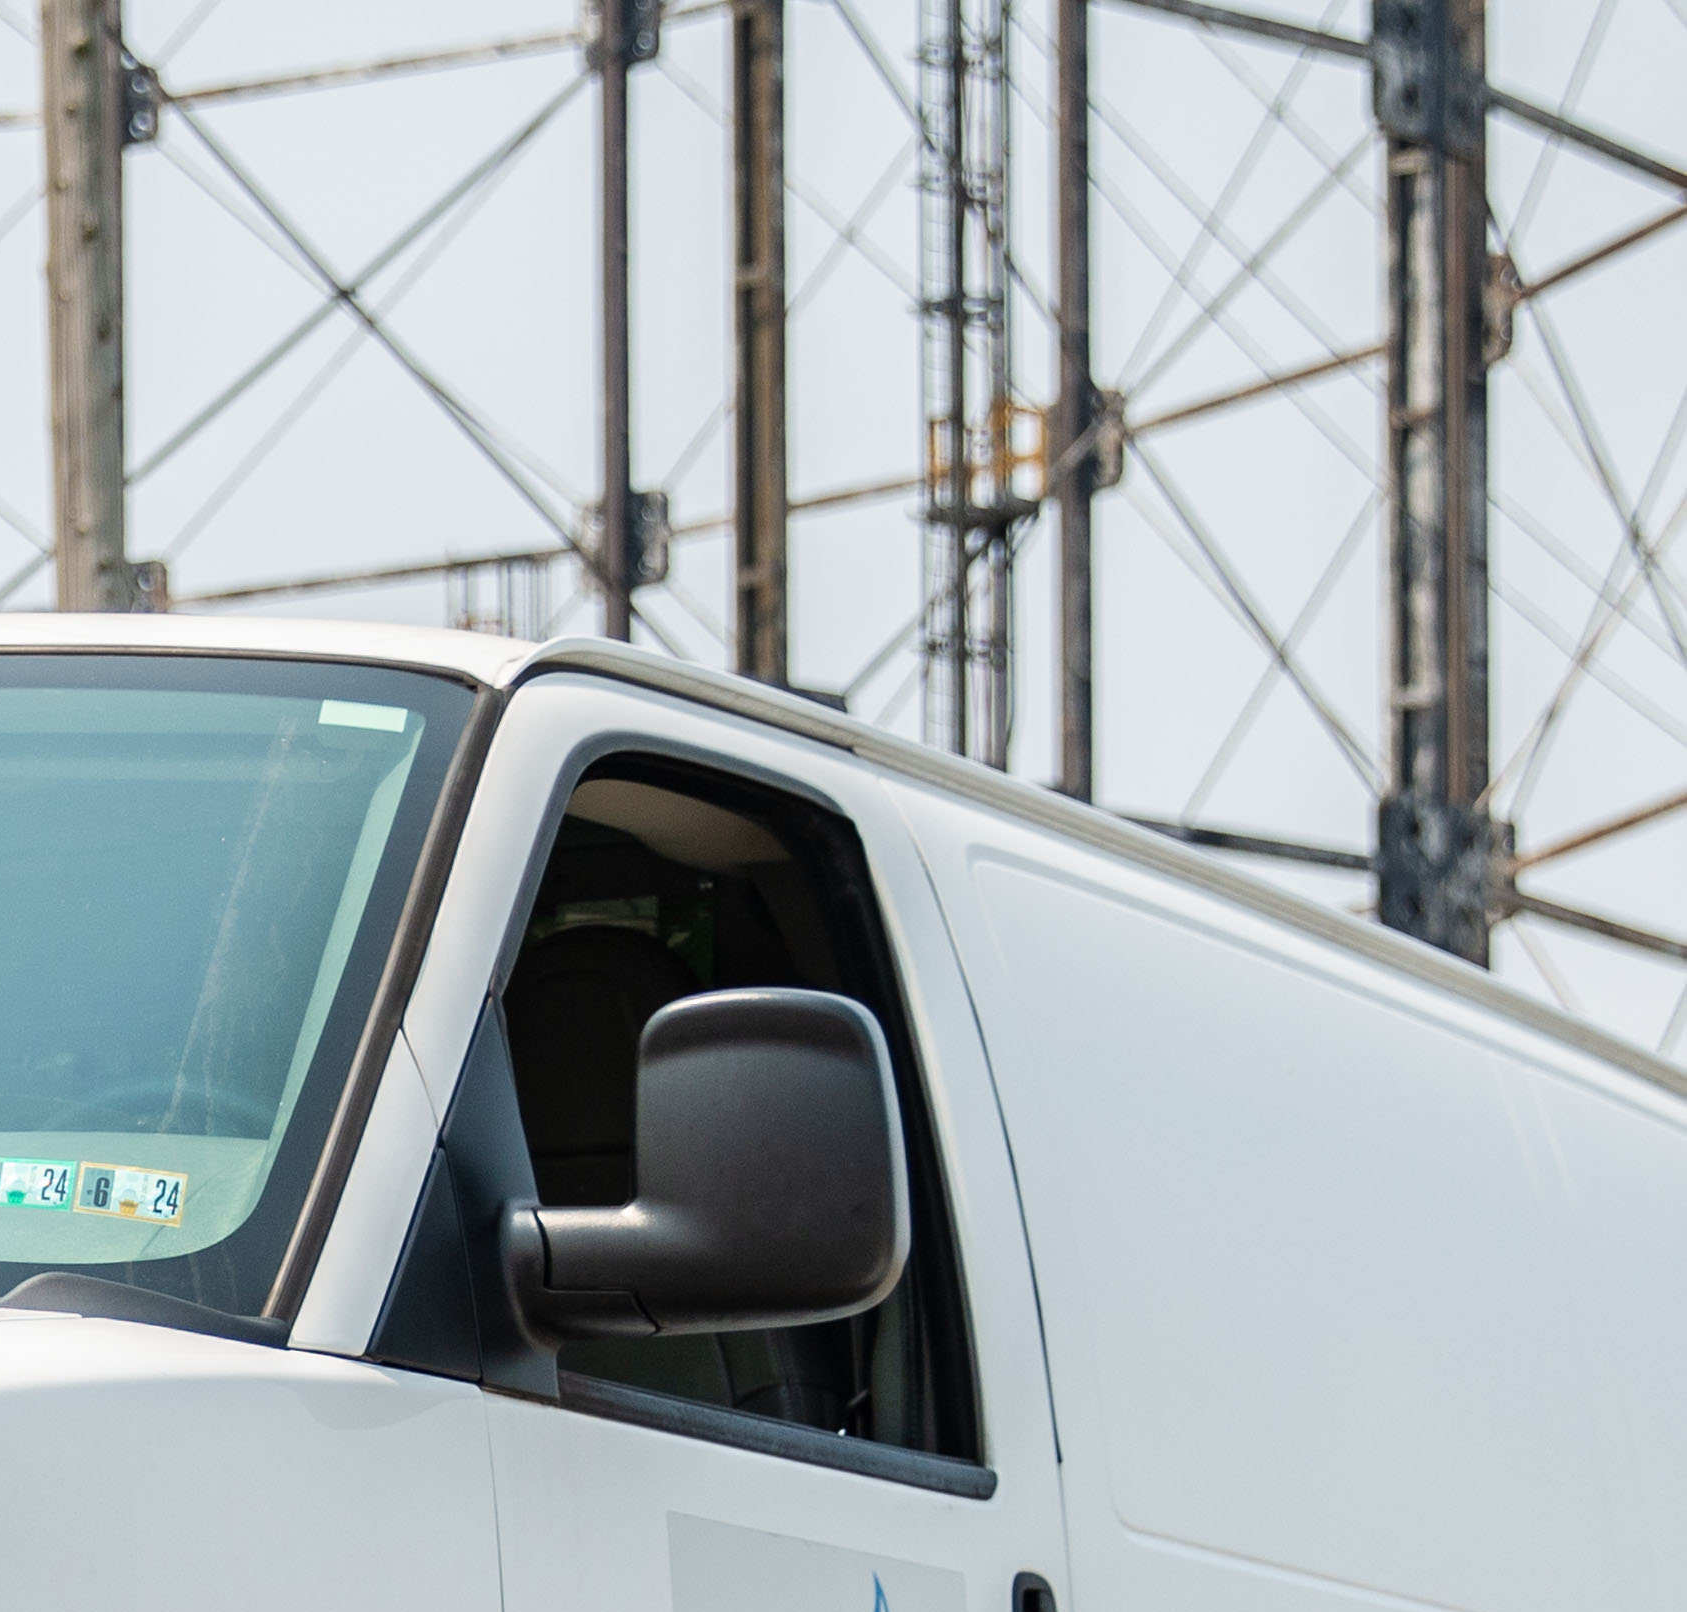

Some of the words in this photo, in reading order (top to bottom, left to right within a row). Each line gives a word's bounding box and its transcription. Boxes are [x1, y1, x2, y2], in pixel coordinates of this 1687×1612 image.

[41, 1168, 68, 1202] 24
[93, 1176, 110, 1208] 6
[152, 1178, 179, 1215] 24
